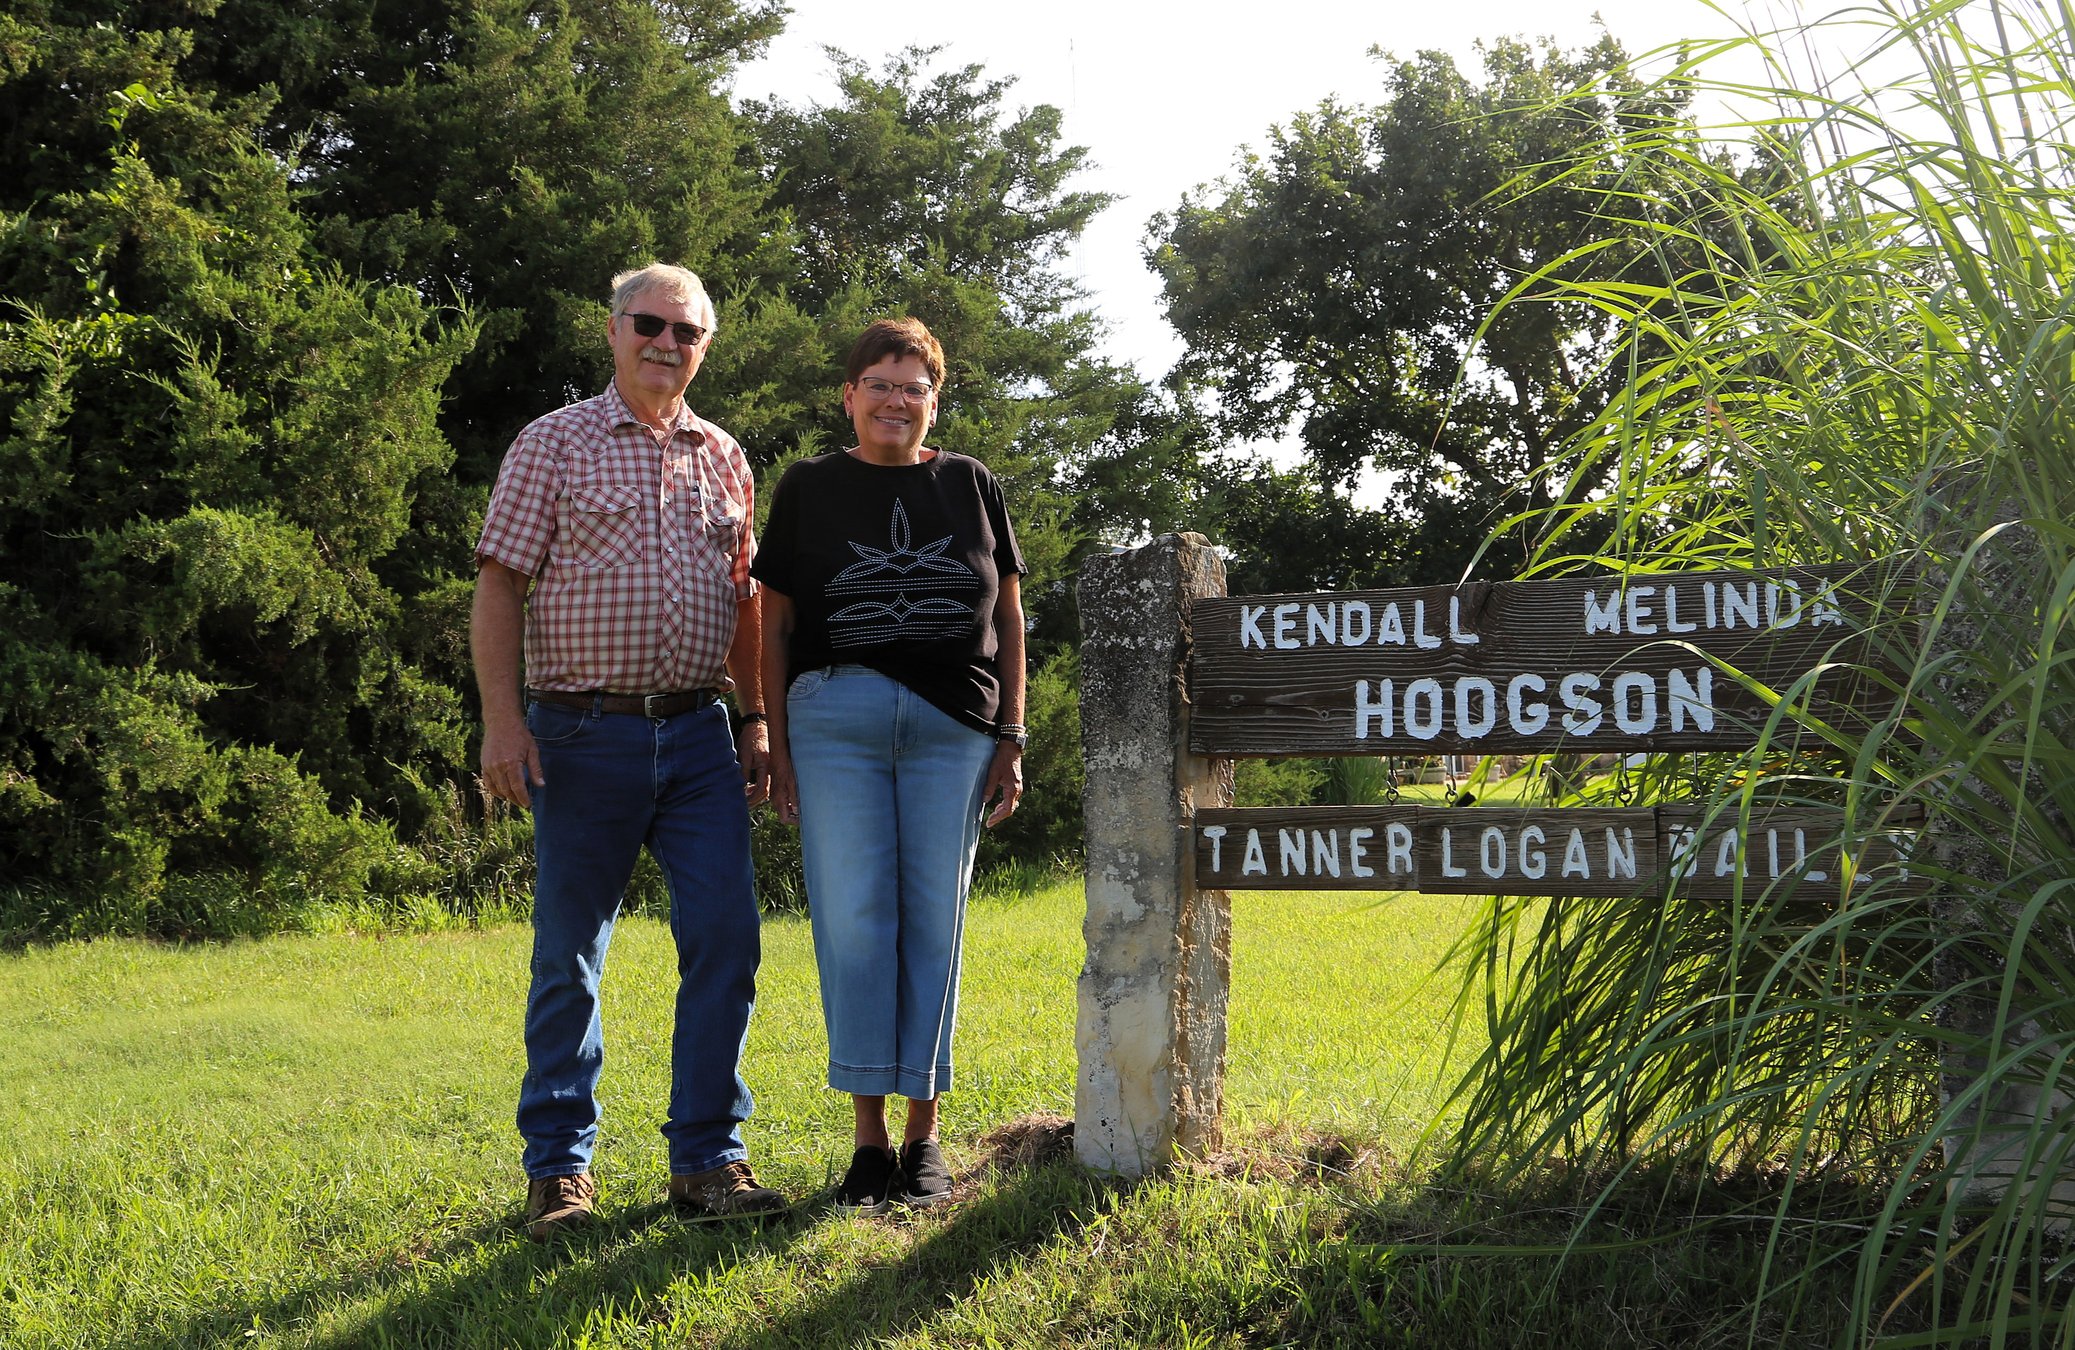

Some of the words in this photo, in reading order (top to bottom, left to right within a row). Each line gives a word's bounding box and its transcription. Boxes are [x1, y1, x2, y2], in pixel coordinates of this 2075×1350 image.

[1240, 595, 1480, 649] KENDALL
[1584, 576, 1842, 635] MELINDA
[1355, 667, 1715, 740] HODGSON
[1203, 822, 1413, 878] TANNER
[1441, 825, 1637, 880] LOGAN
